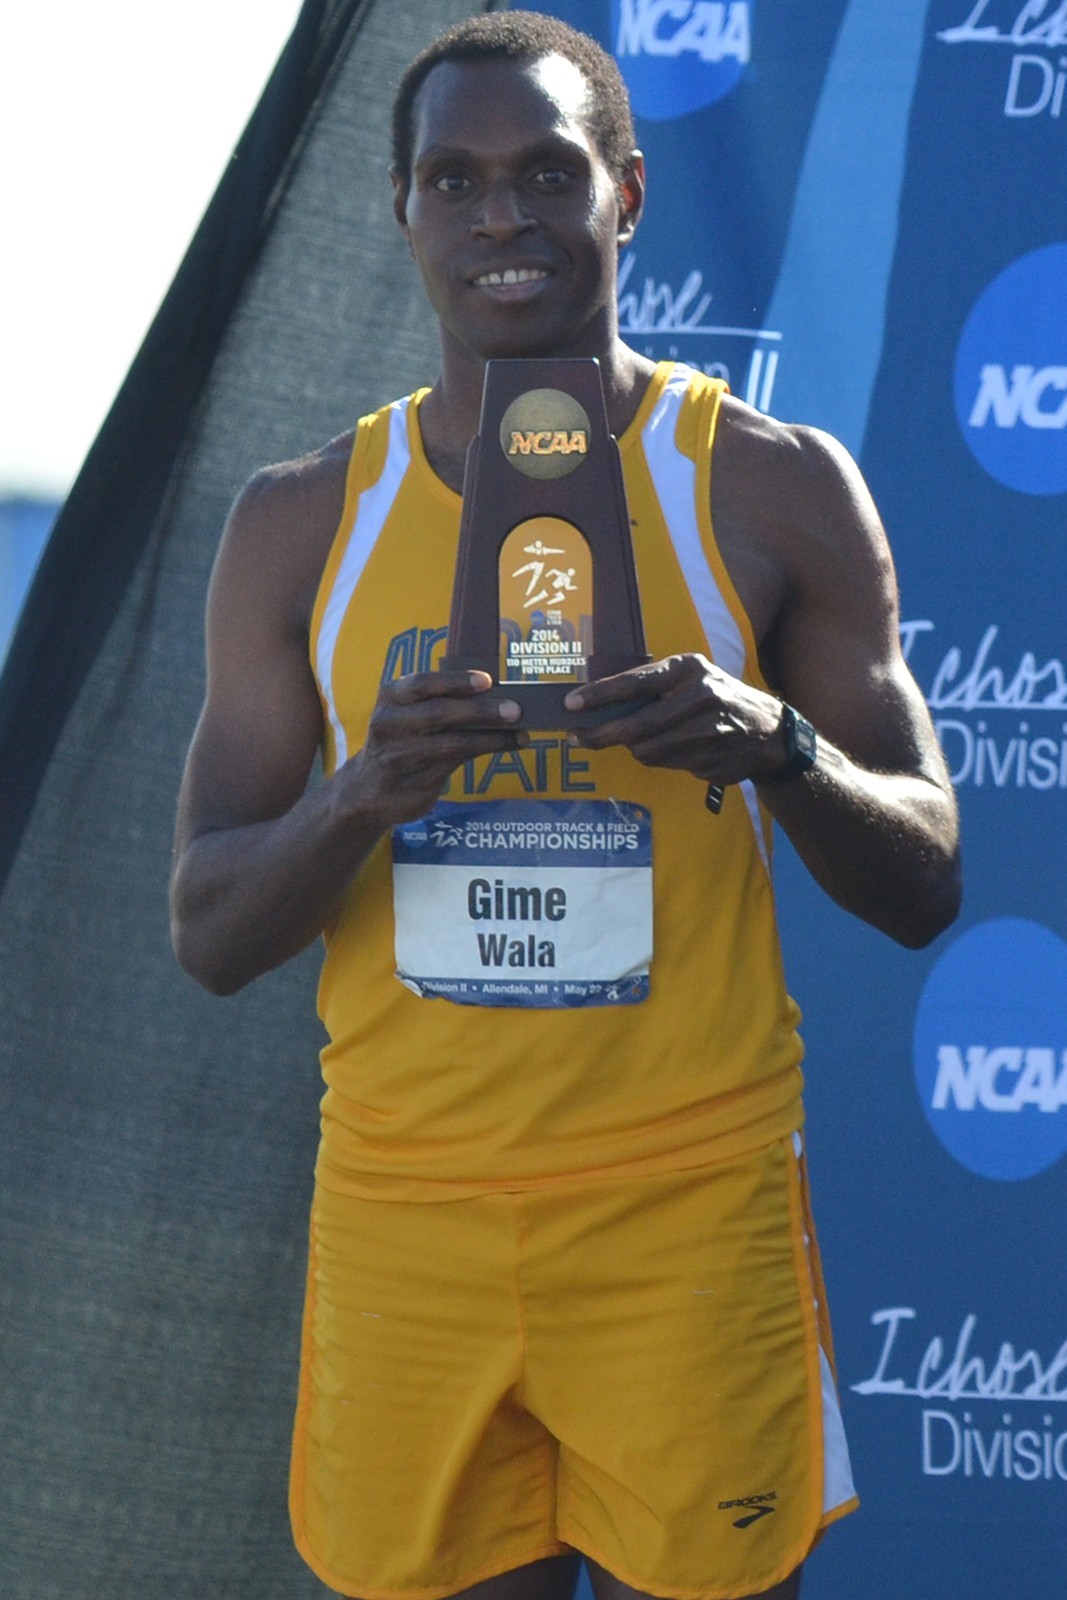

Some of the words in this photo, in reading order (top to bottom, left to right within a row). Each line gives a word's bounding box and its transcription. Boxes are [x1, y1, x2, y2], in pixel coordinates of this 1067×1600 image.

[616, 0, 749, 63] NCAA
[508, 430, 588, 455] NCAA
[531, 629, 560, 641] 2014
[510, 641, 569, 655] DIVISION
[572, 641, 582, 653] II
[521, 658, 548, 667] METER
[549, 657, 586, 666] HURDLES
[522, 666, 545, 674] FIFTH
[546, 666, 571, 674] PLACE
[465, 821, 491, 832] 2014
[493, 822, 552, 832] OUTDOOR
[555, 822, 594, 832] TRACK
[596, 823, 604, 833] &
[607, 823, 639, 833] FIELD
[464, 832, 639, 849] CHAMPIONSHIPS
[467, 878, 567, 921] Gime
[477, 933, 556, 967] Wala
[460, 983, 467, 992] II
[482, 984, 533, 995] Allendale,
[534, 984, 548, 993] MI
[564, 984, 587, 996] May
[718, 1491, 777, 1510] BROOKS
